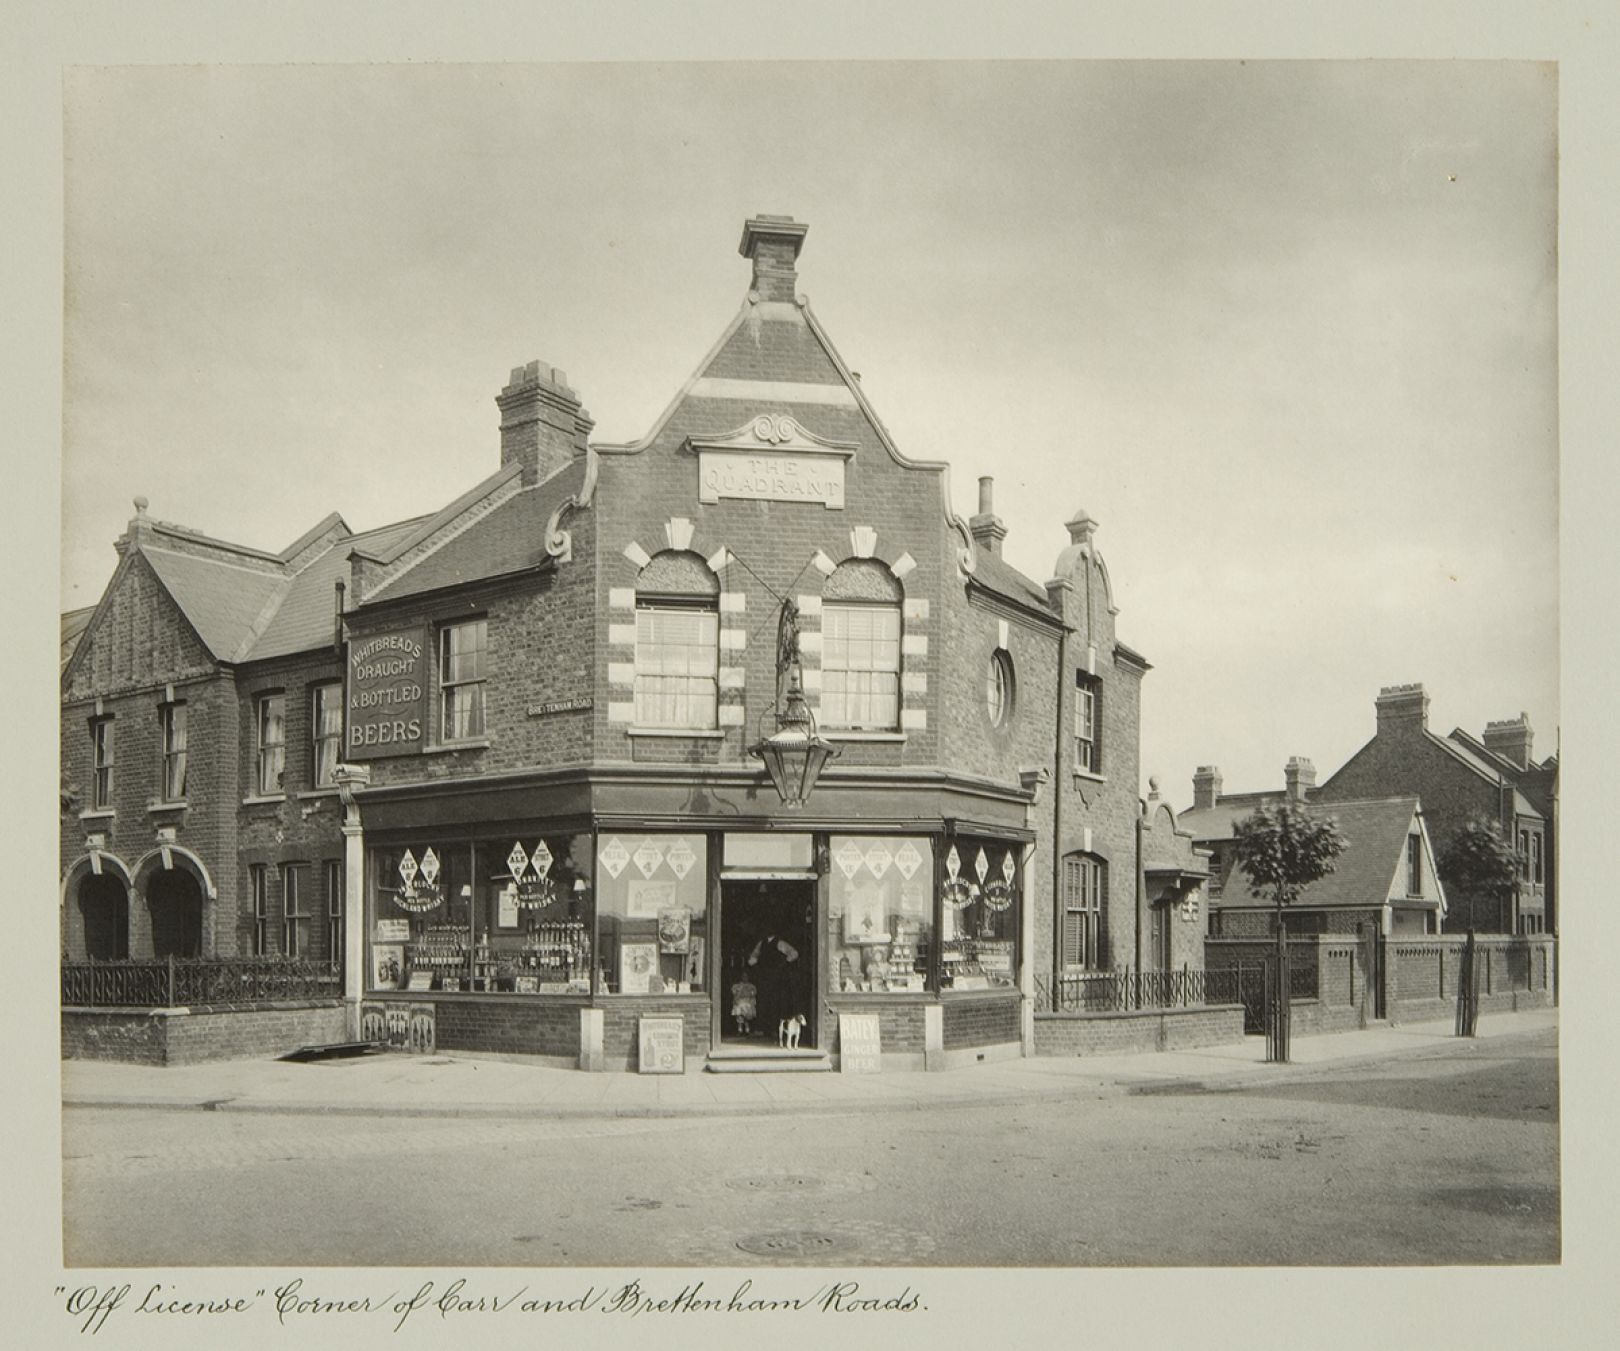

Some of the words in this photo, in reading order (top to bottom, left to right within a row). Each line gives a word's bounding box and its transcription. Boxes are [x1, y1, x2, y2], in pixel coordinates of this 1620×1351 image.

[749, 460, 798, 476] THE
[704, 469, 840, 496] QUADRANT
[351, 636, 422, 667] WHITBREADS
[357, 659, 416, 681] DRAUGHT
[351, 694, 360, 709] &
[361, 685, 422, 708] BOTTLED
[351, 719, 422, 746] BEERS
[848, 1057, 875, 1069] BEER
[274, 1278, 394, 1325] Corner
[394, 1281, 434, 1334] of
[432, 1278, 516, 1319] Carr
[521, 1286, 608, 1313] and
[601, 1278, 820, 1318] Brettenham
[820, 1281, 928, 1313] Roads.
